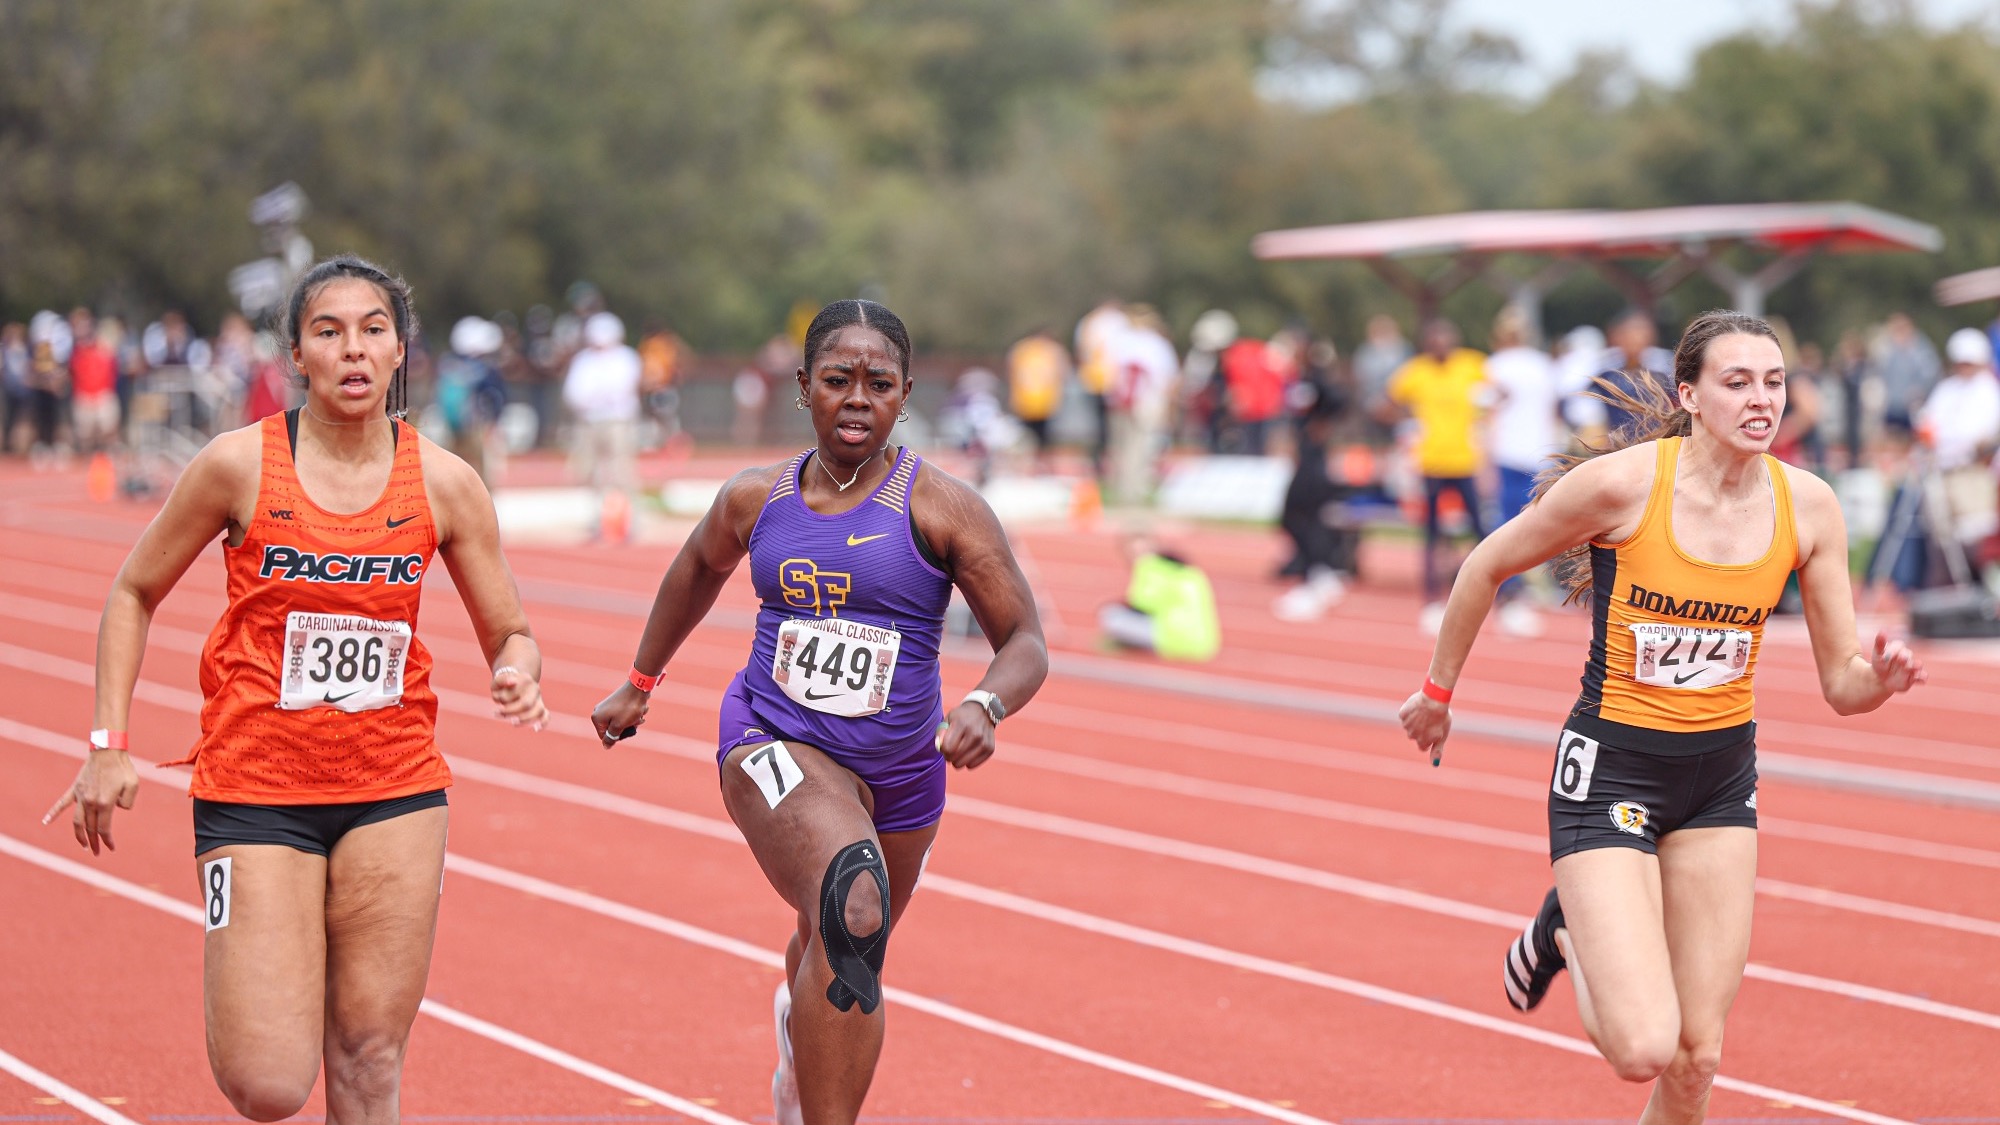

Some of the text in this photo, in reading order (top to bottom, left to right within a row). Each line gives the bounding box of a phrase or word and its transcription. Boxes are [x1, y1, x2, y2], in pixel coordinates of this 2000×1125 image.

[259, 545, 423, 584] PACIFIC
[779, 558, 851, 617] SF
[298, 615, 401, 632] CARDINAL CLASSIC
[846, 624, 890, 645] CLASSIC
[309, 637, 383, 683] 386
[796, 636, 872, 690] 449
[750, 746, 785, 796] 7
[1560, 737, 1586, 794] 6
[210, 864, 224, 925] 8
